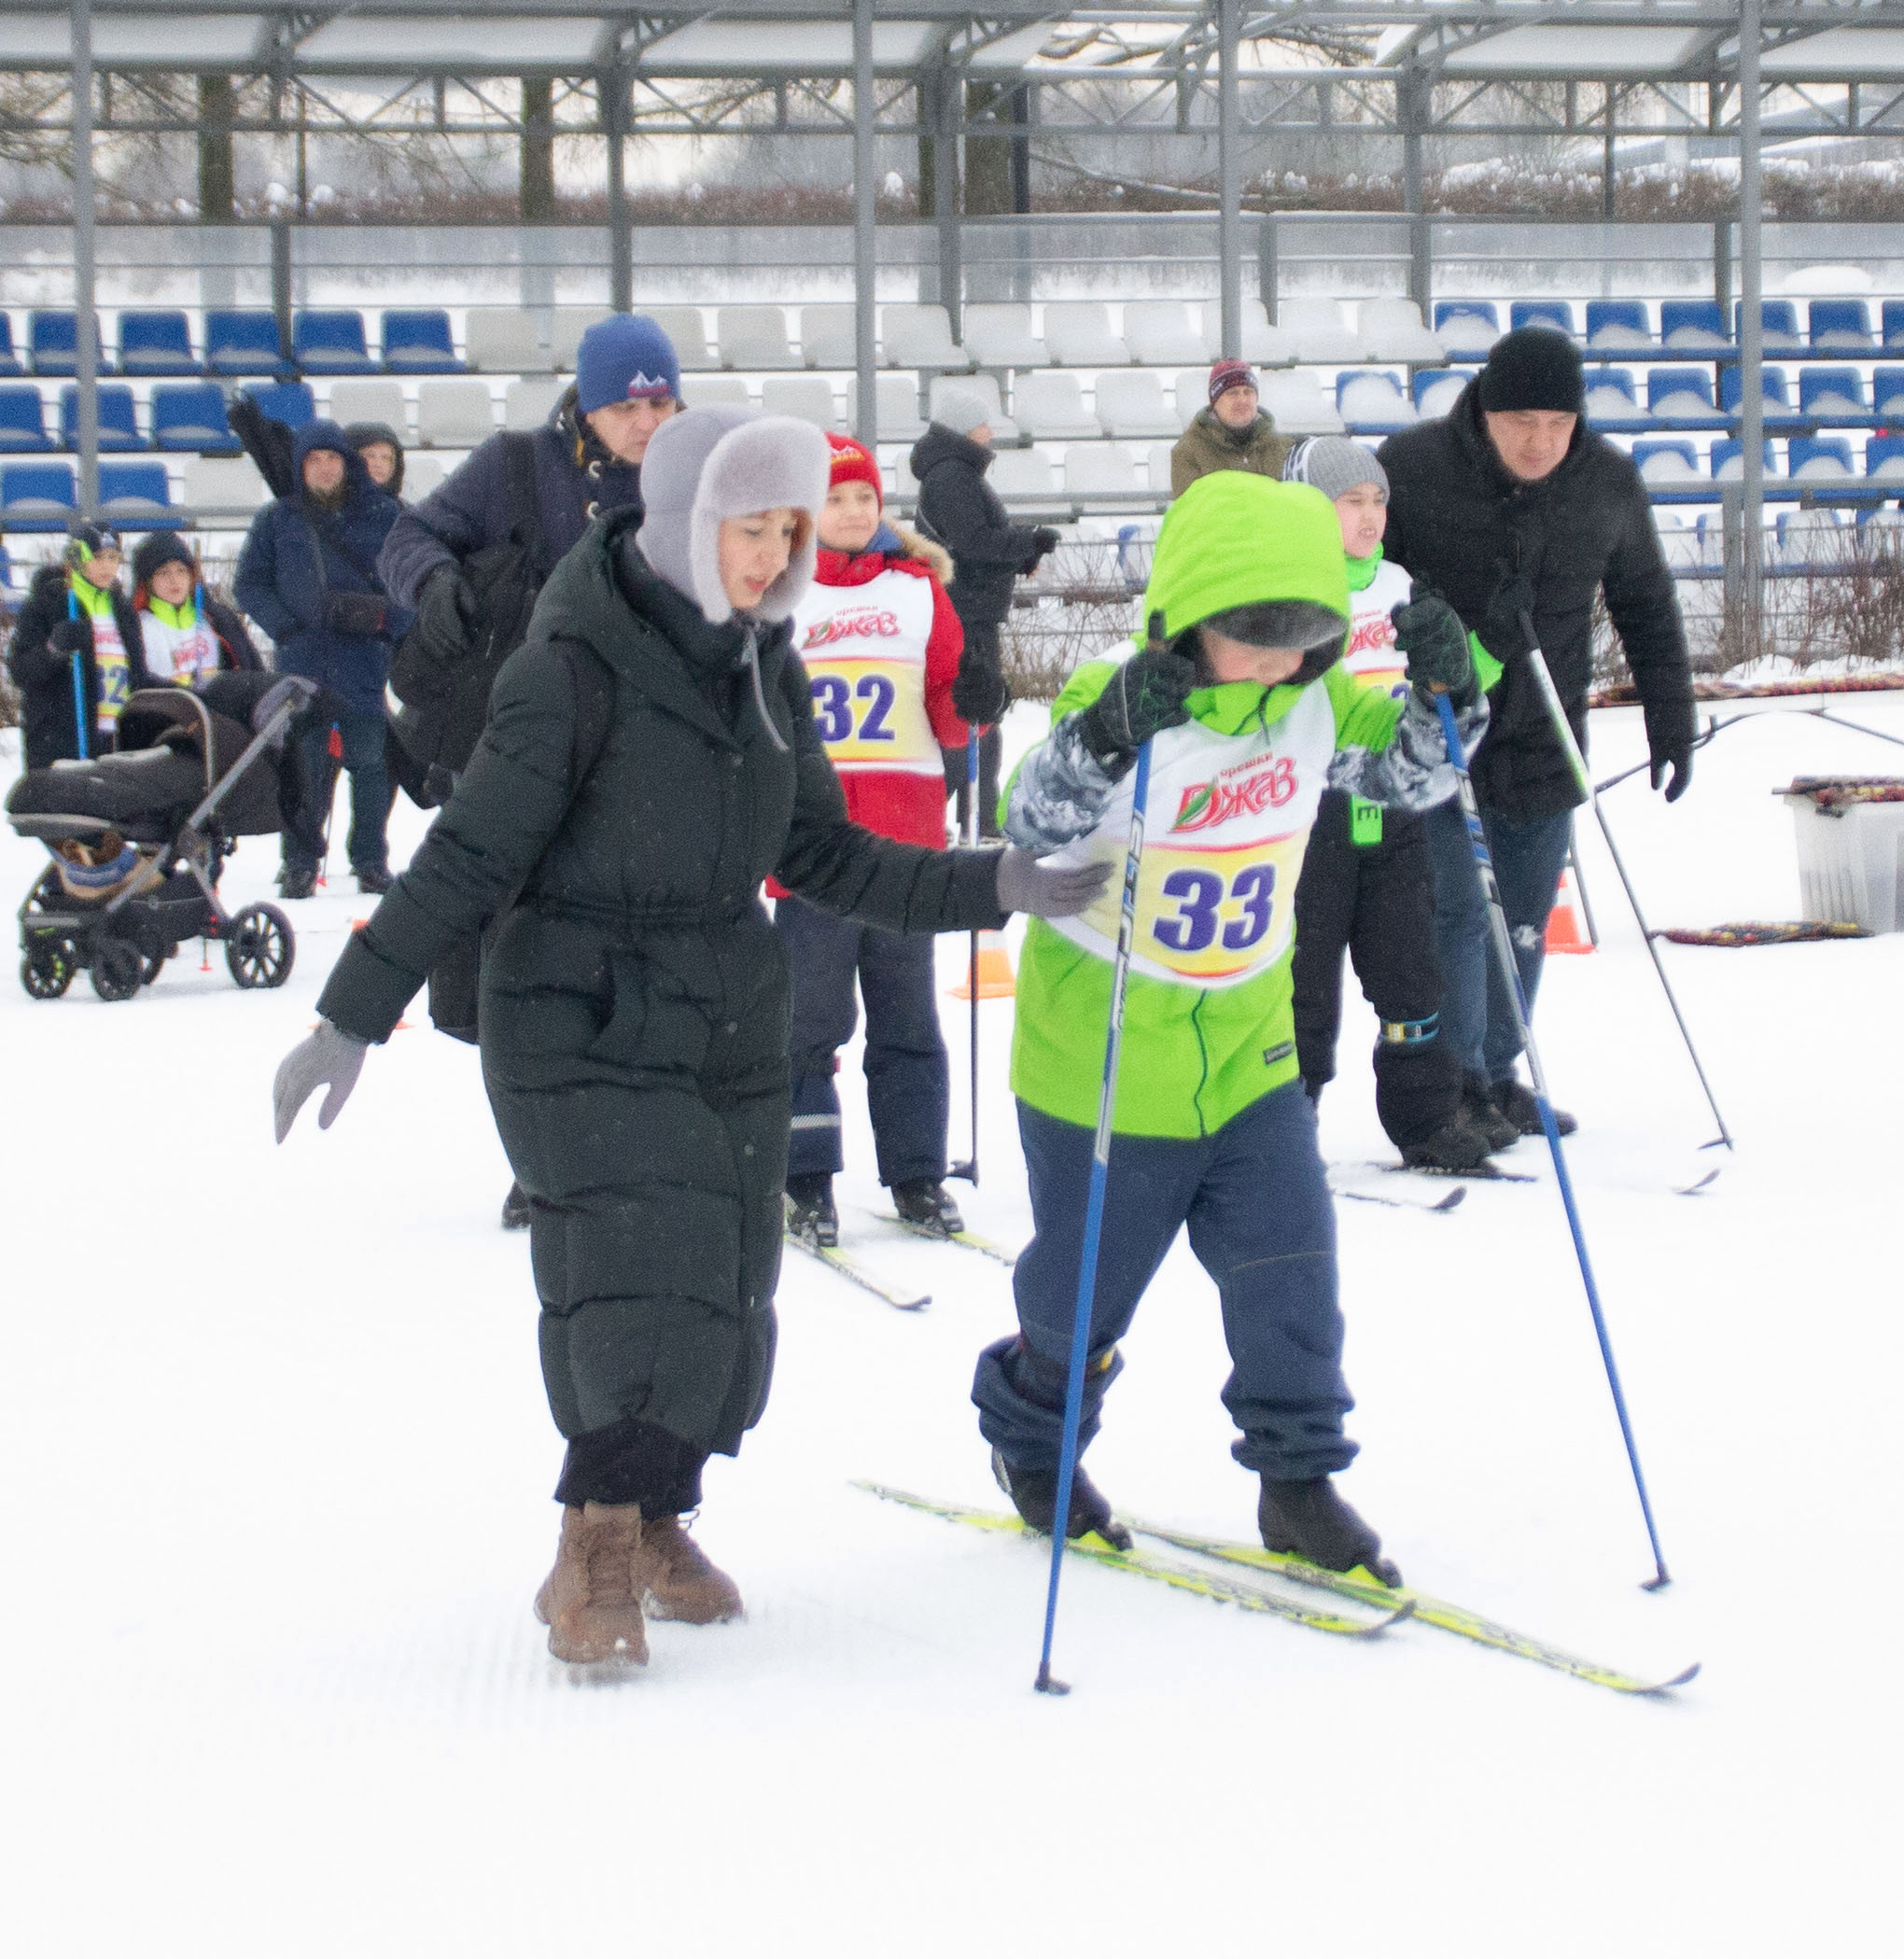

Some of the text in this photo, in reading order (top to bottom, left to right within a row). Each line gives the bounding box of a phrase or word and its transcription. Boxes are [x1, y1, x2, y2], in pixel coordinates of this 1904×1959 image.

[810, 674, 896, 742] 32
[1168, 756, 1299, 833] Джаз
[1219, 751, 1273, 778] орешки
[1153, 862, 1278, 952] 33
